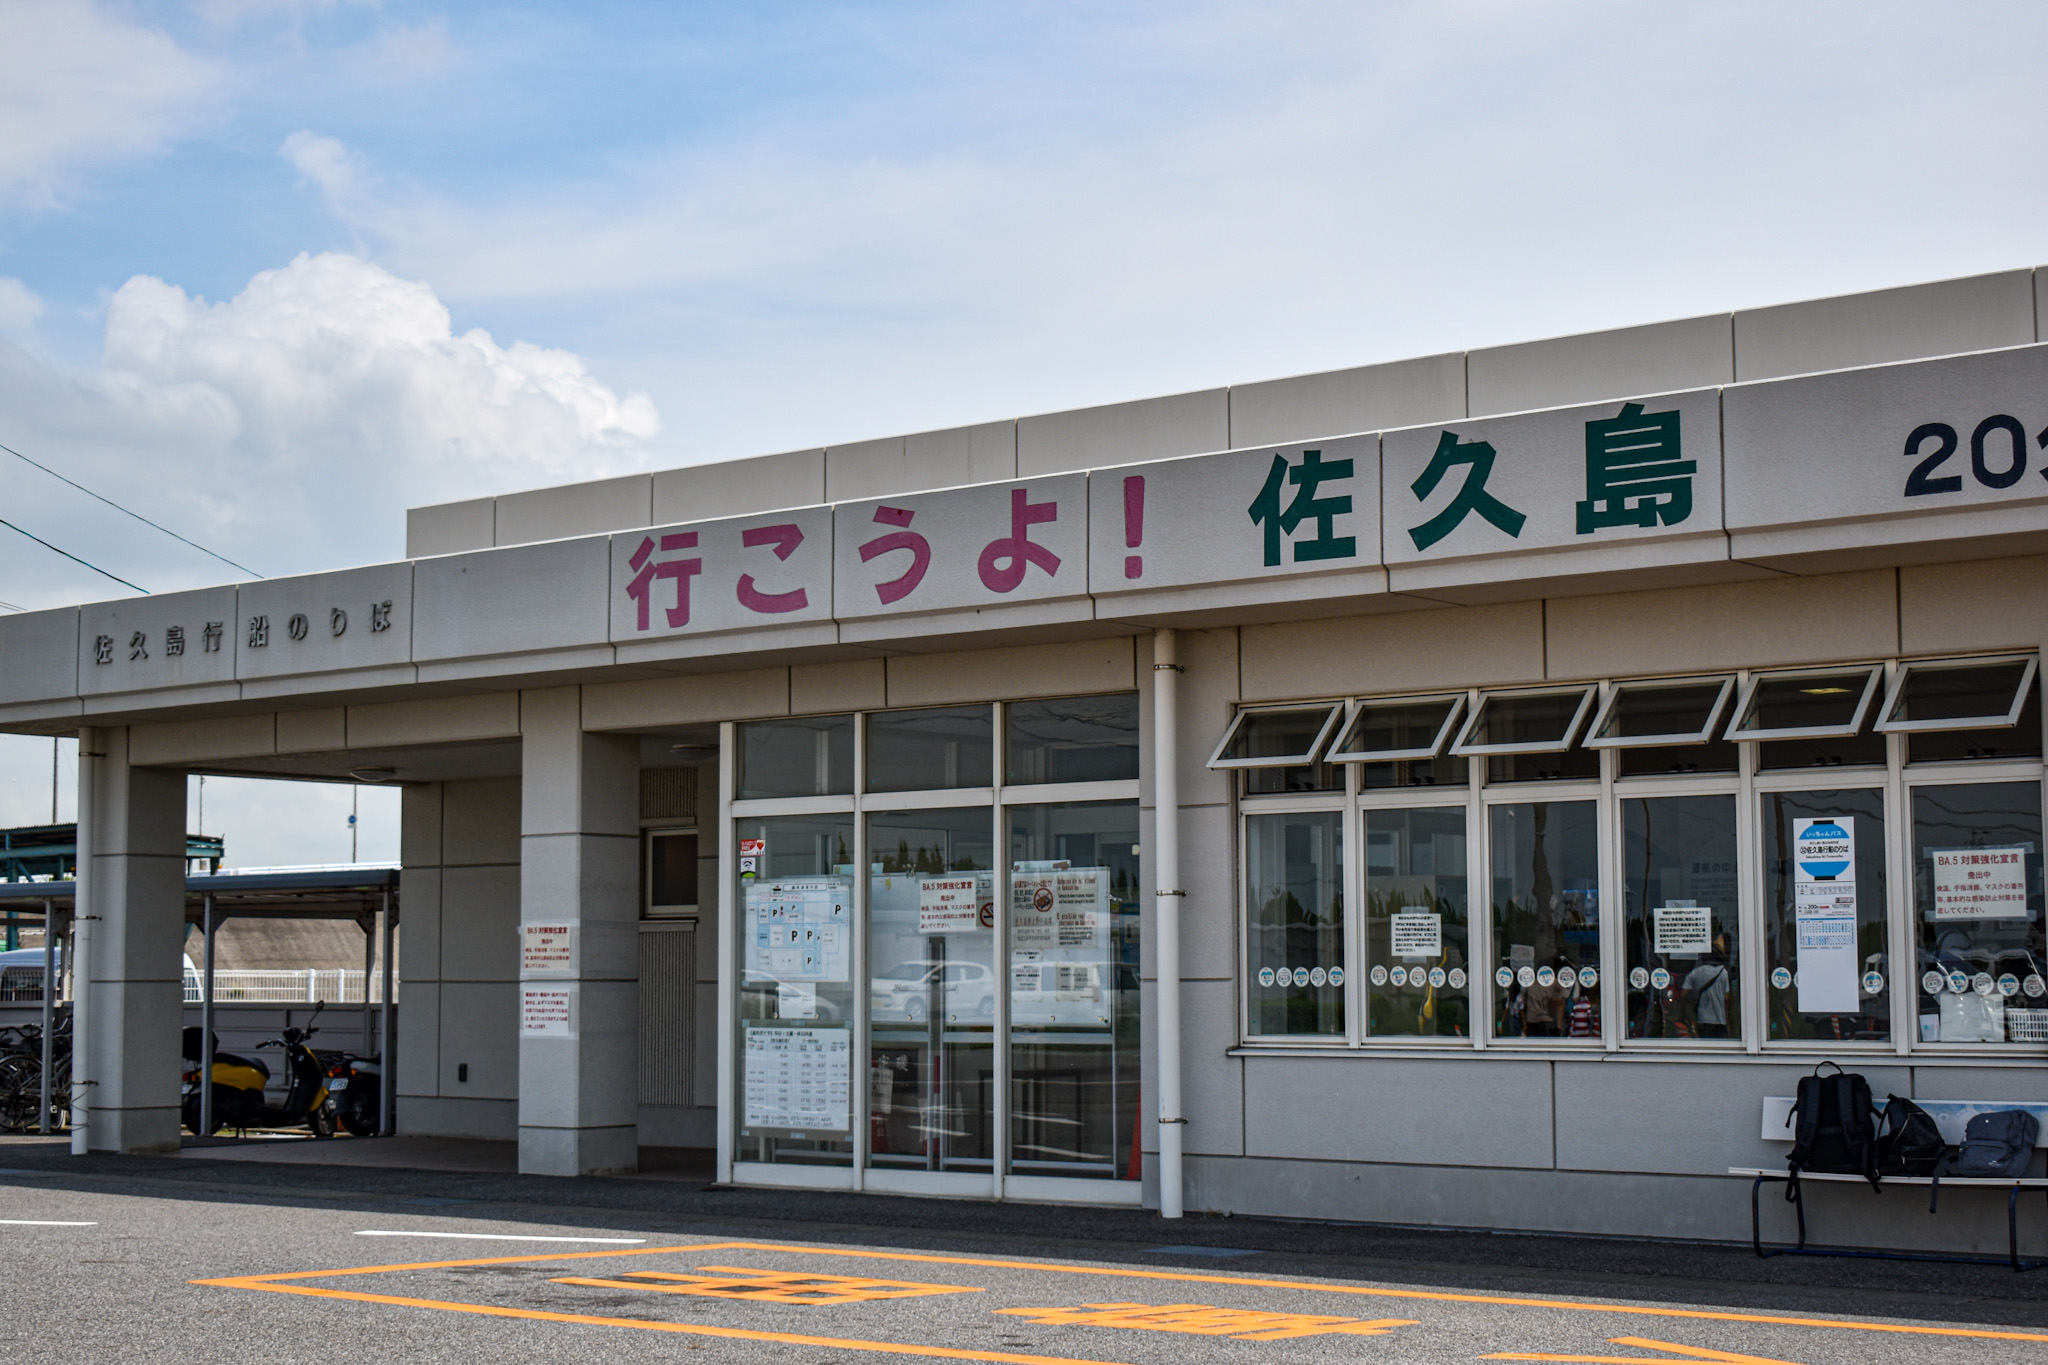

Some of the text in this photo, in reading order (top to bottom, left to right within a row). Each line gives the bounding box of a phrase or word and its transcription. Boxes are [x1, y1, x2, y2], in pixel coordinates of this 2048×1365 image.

[1248, 402, 1698, 567] 佐久島
[1903, 414, 2048, 497] 20
[93, 600, 393, 664] 佐久島行船のりば
[1938, 853, 2019, 866] BA.5 対策強化宣言
[1968, 871, 1991, 879] 発出中
